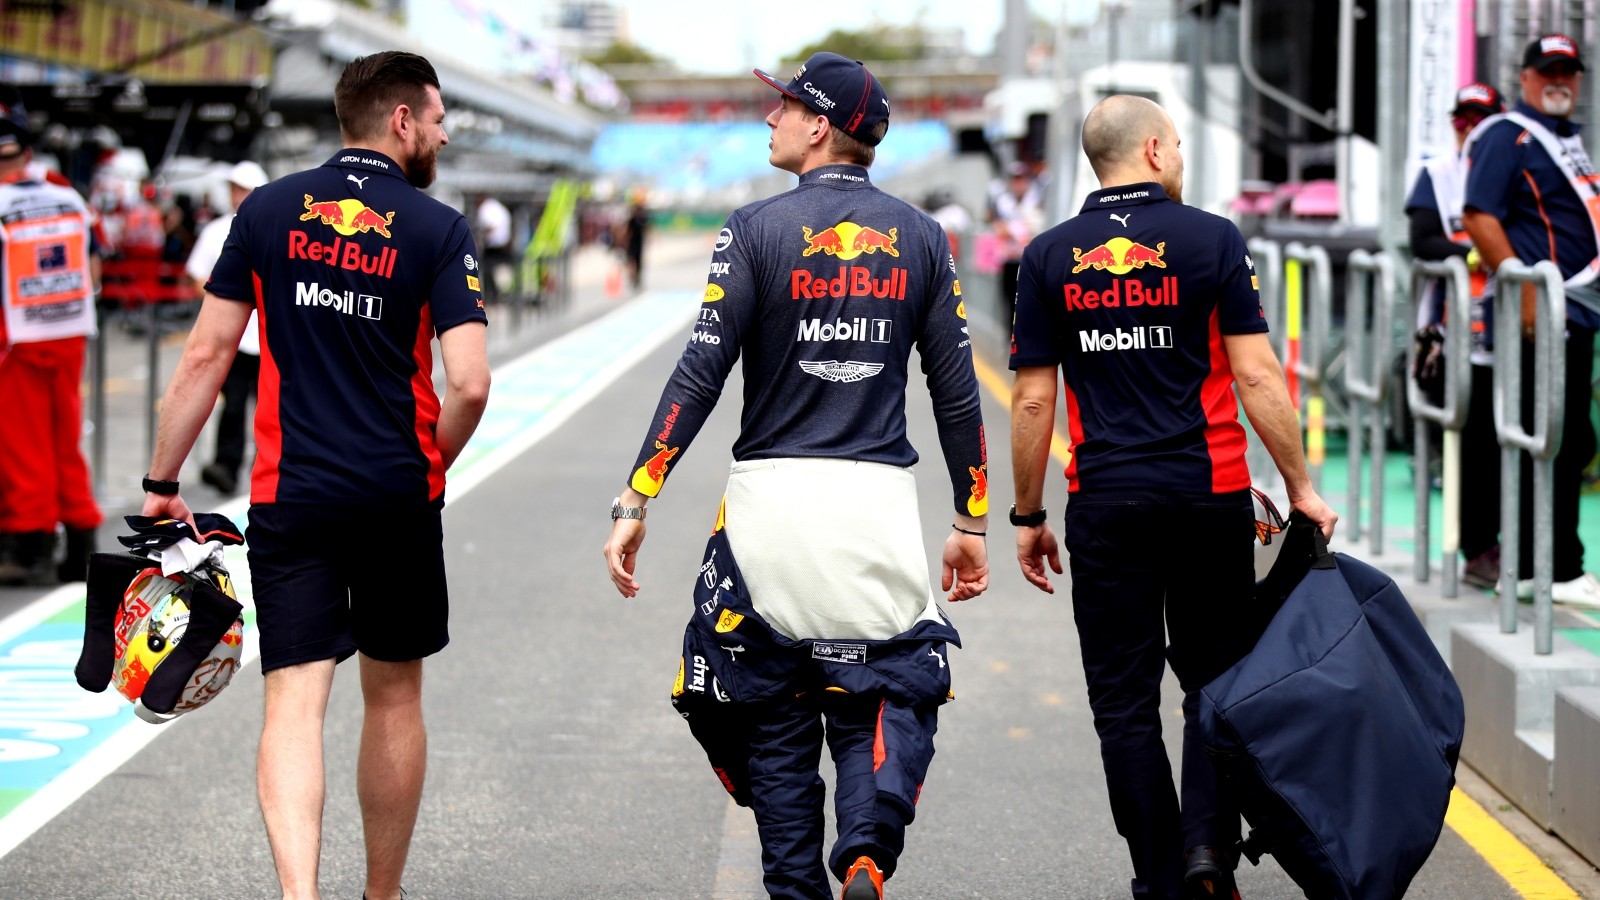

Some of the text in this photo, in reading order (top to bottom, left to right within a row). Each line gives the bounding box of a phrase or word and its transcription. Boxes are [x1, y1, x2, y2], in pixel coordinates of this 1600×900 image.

[804, 82, 836, 109] CarNext
[340, 155, 389, 169] ASTON MARTIN
[842, 174, 865, 183] MARTIN
[1099, 190, 1149, 203] ASTON MARTIN
[288, 230, 398, 279] Red Bull
[791, 266, 908, 300] Red Bull
[1063, 276, 1179, 312] Red Bull
[797, 318, 867, 342] Mobil
[1078, 326, 1146, 353] Mobil
[657, 402, 681, 442] Red Bull
